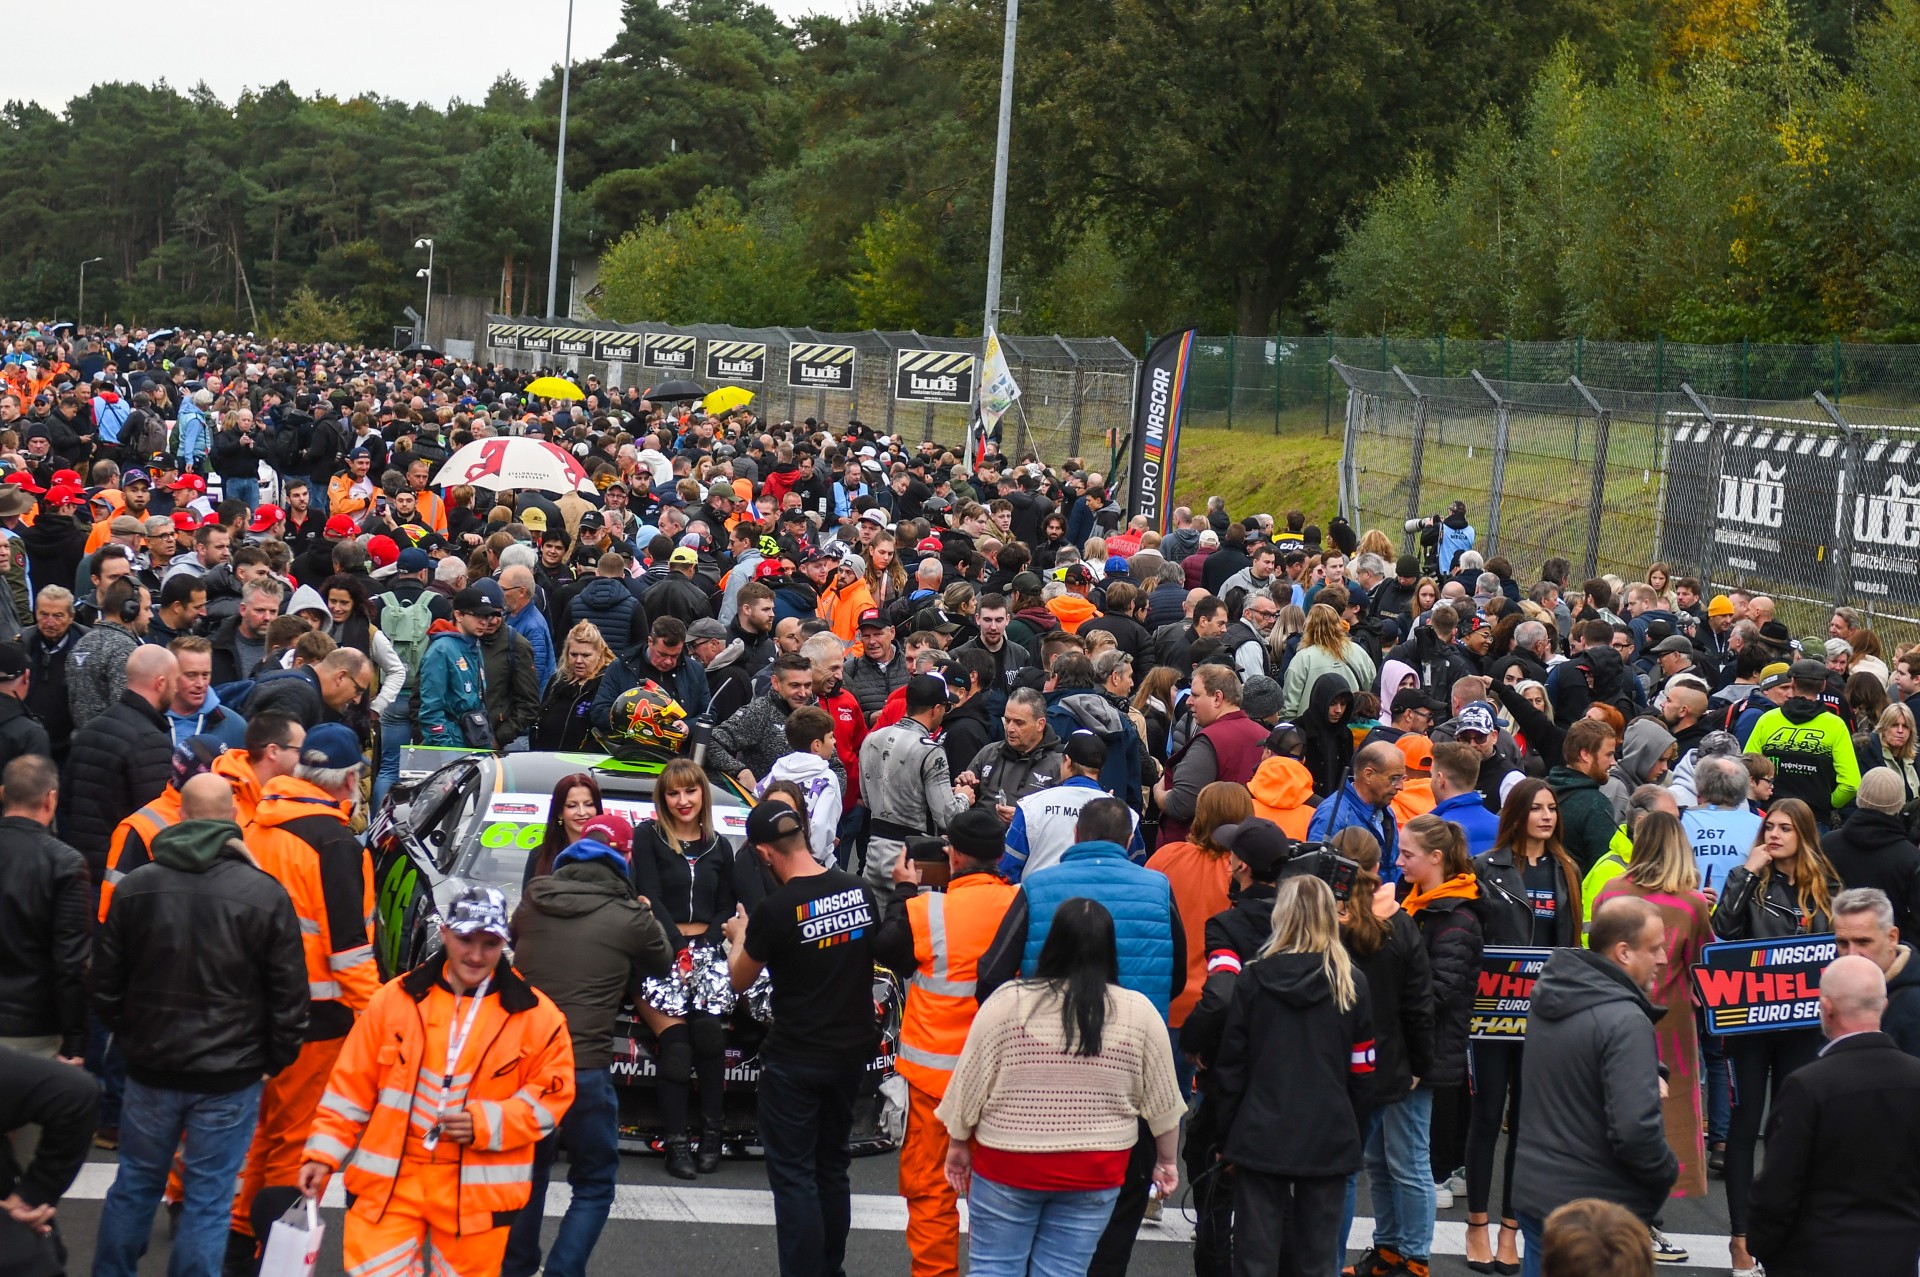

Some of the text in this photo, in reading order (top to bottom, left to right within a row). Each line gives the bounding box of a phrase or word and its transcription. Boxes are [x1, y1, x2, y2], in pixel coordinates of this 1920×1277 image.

[1140, 367, 1171, 519] EURO NASCAR
[1823, 694, 1840, 705] LIFE
[1765, 726, 1826, 751] 46
[1780, 762, 1818, 772] MONSTER
[1045, 805, 1081, 818] PIT MA
[480, 821, 547, 850] 66
[1696, 828, 1726, 840] 267
[815, 888, 864, 916] NASCAR
[803, 908, 872, 938] OFFICIAL
[1770, 943, 1837, 966] NASCAR
[1694, 967, 1827, 1007] WHEL
[1496, 999, 1531, 1011] EURO
[1748, 1003, 1791, 1023] EURO
